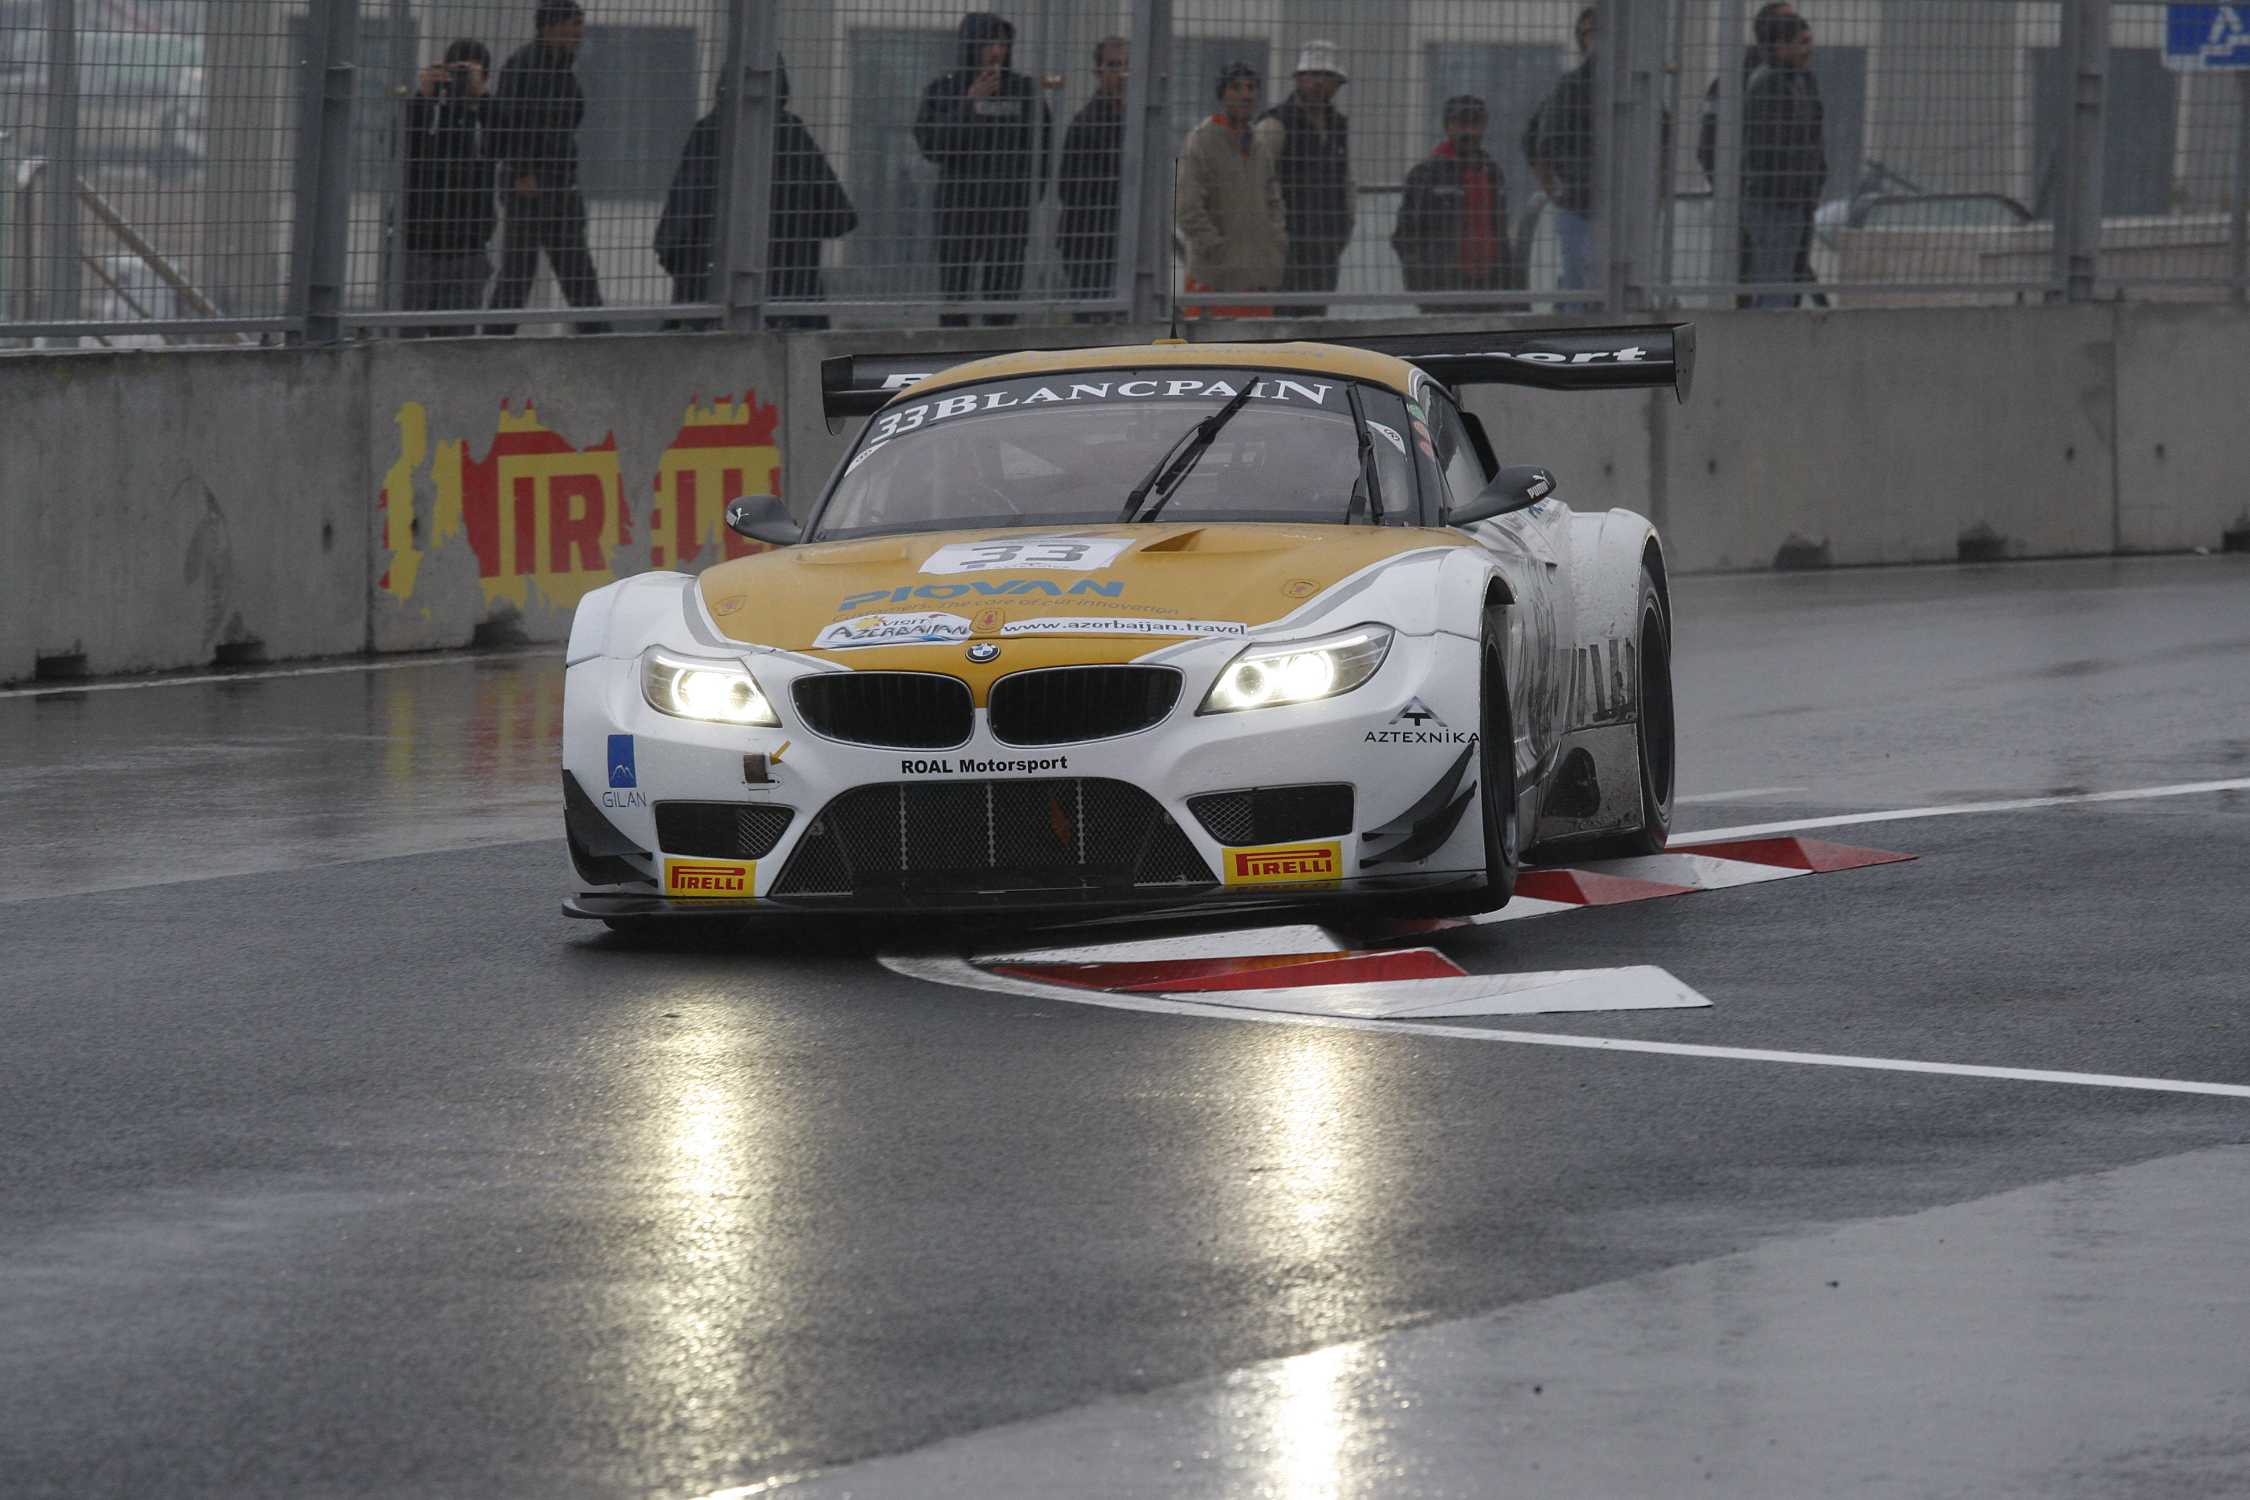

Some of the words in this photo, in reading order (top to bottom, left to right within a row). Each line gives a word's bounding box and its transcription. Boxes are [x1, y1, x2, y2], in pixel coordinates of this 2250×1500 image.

[929, 379, 1333, 422] BLANCPAIN
[870, 405, 929, 444] 33
[959, 543, 1090, 566] 33
[838, 579, 1126, 612] PIOVAN
[901, 760, 954, 774] ROAL
[959, 755, 1069, 773] Motorsport
[602, 791, 647, 808] GILAN
[1235, 848, 1333, 878] PIRELLI
[671, 865, 747, 892] PIRELLI
